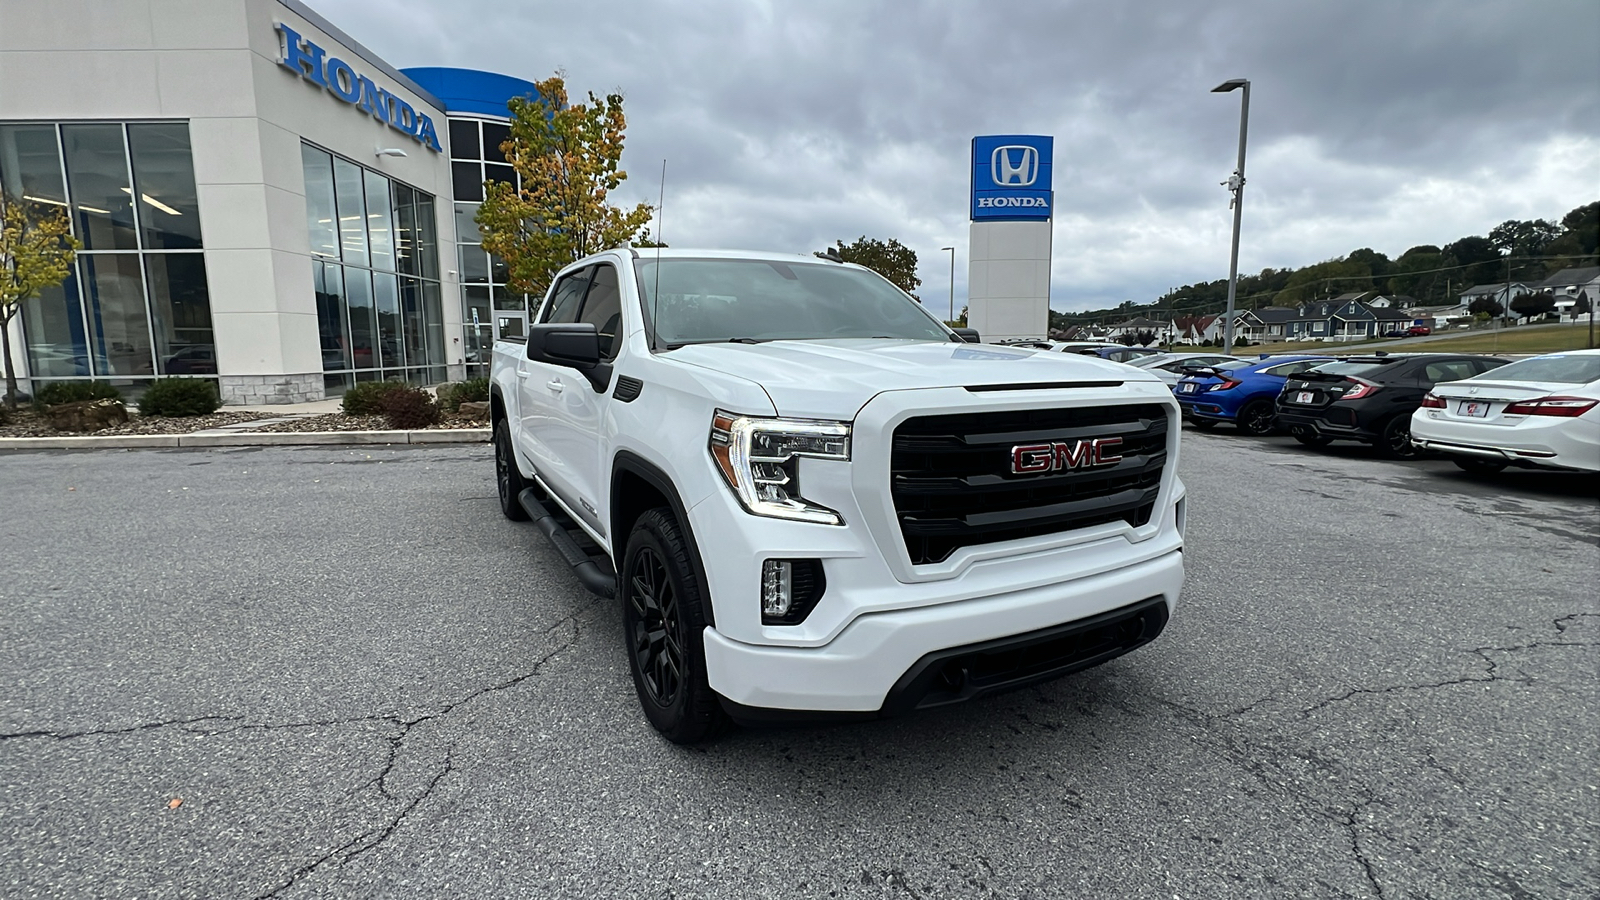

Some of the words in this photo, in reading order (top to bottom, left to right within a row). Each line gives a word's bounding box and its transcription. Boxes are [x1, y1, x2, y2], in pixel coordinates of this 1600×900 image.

[275, 22, 443, 153] HONDA
[978, 197, 1049, 208] HONDA
[1011, 436, 1123, 474] GMC
